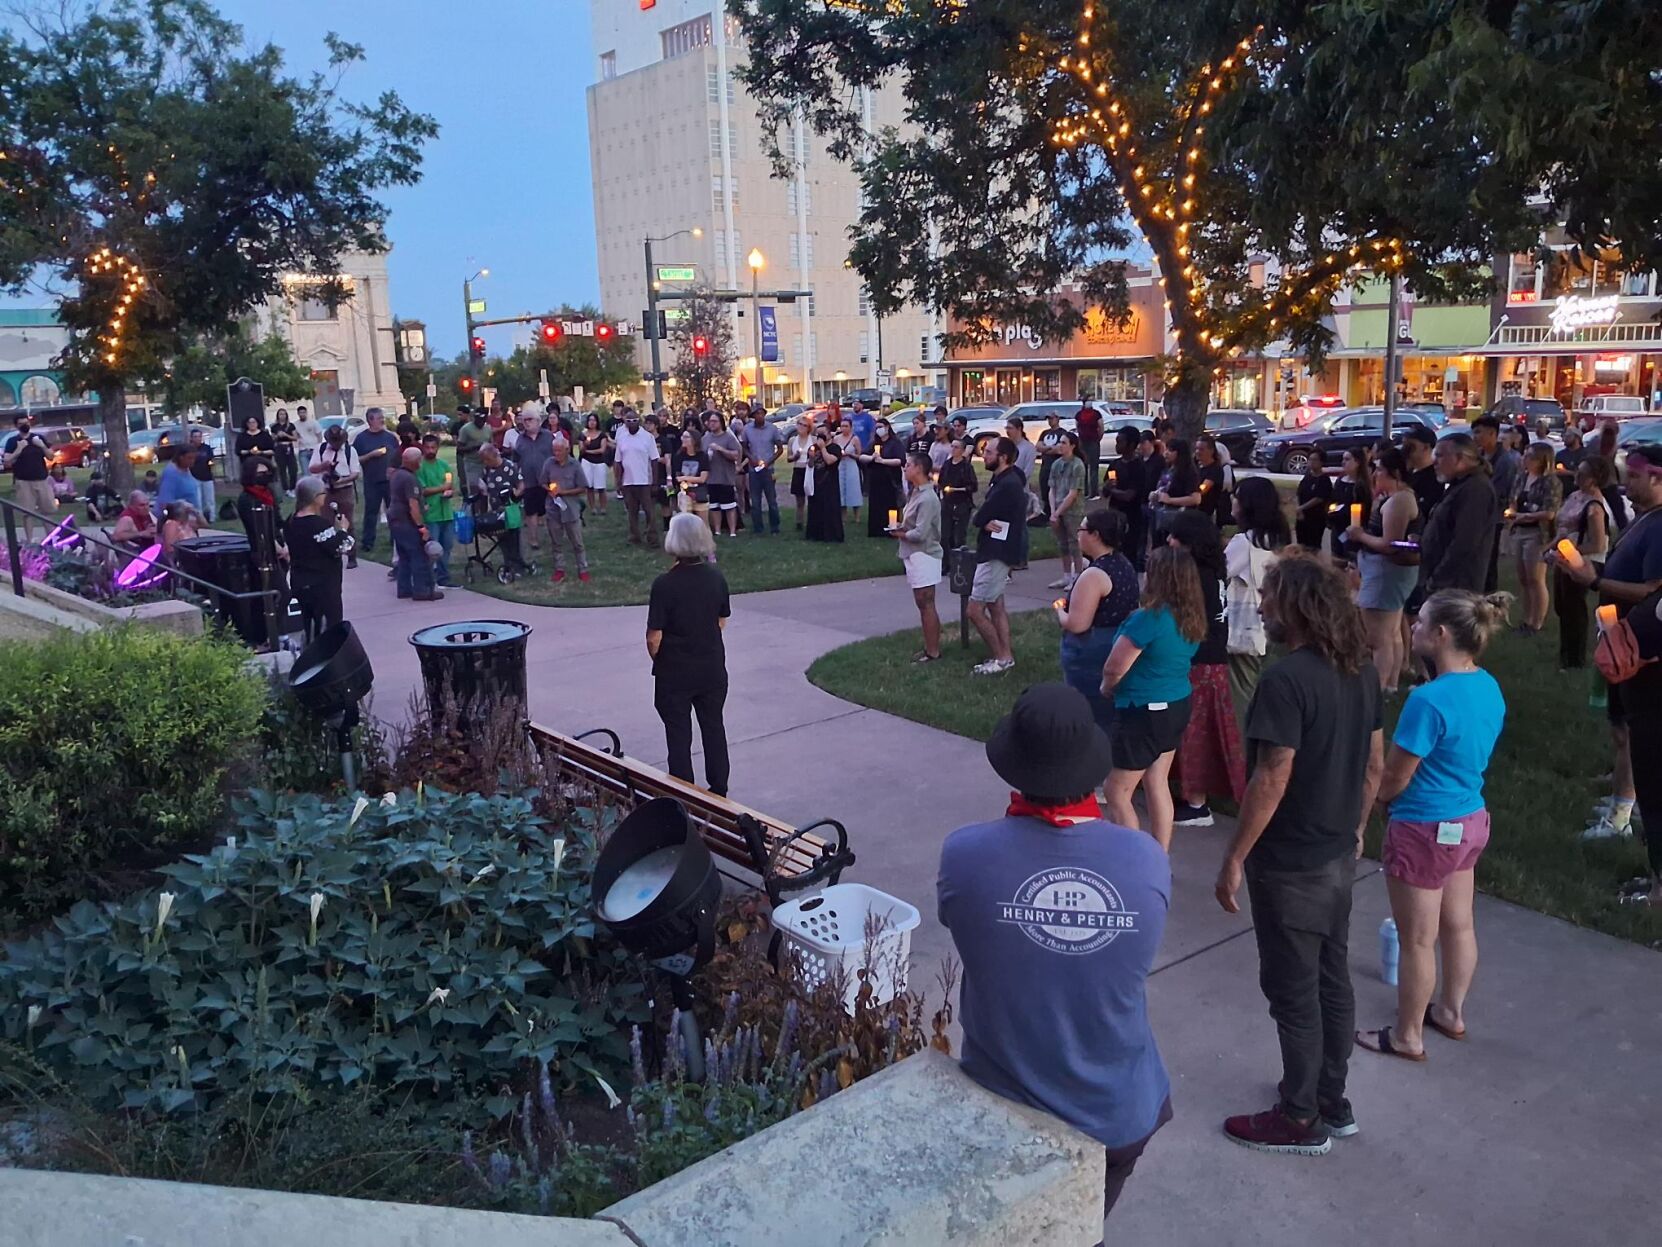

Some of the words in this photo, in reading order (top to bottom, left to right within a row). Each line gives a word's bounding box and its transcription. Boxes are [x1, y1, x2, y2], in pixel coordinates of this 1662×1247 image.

[1021, 876, 1049, 903] Certified
[1049, 871, 1077, 882] Public
[1078, 873, 1118, 909] Accountants
[1003, 906, 1055, 924] HENRY
[1060, 912, 1071, 924] &
[1077, 913, 1134, 928] PETERS
[1025, 924, 1045, 943] More
[1046, 939, 1067, 951] Than
[1069, 930, 1115, 952] Accounting
